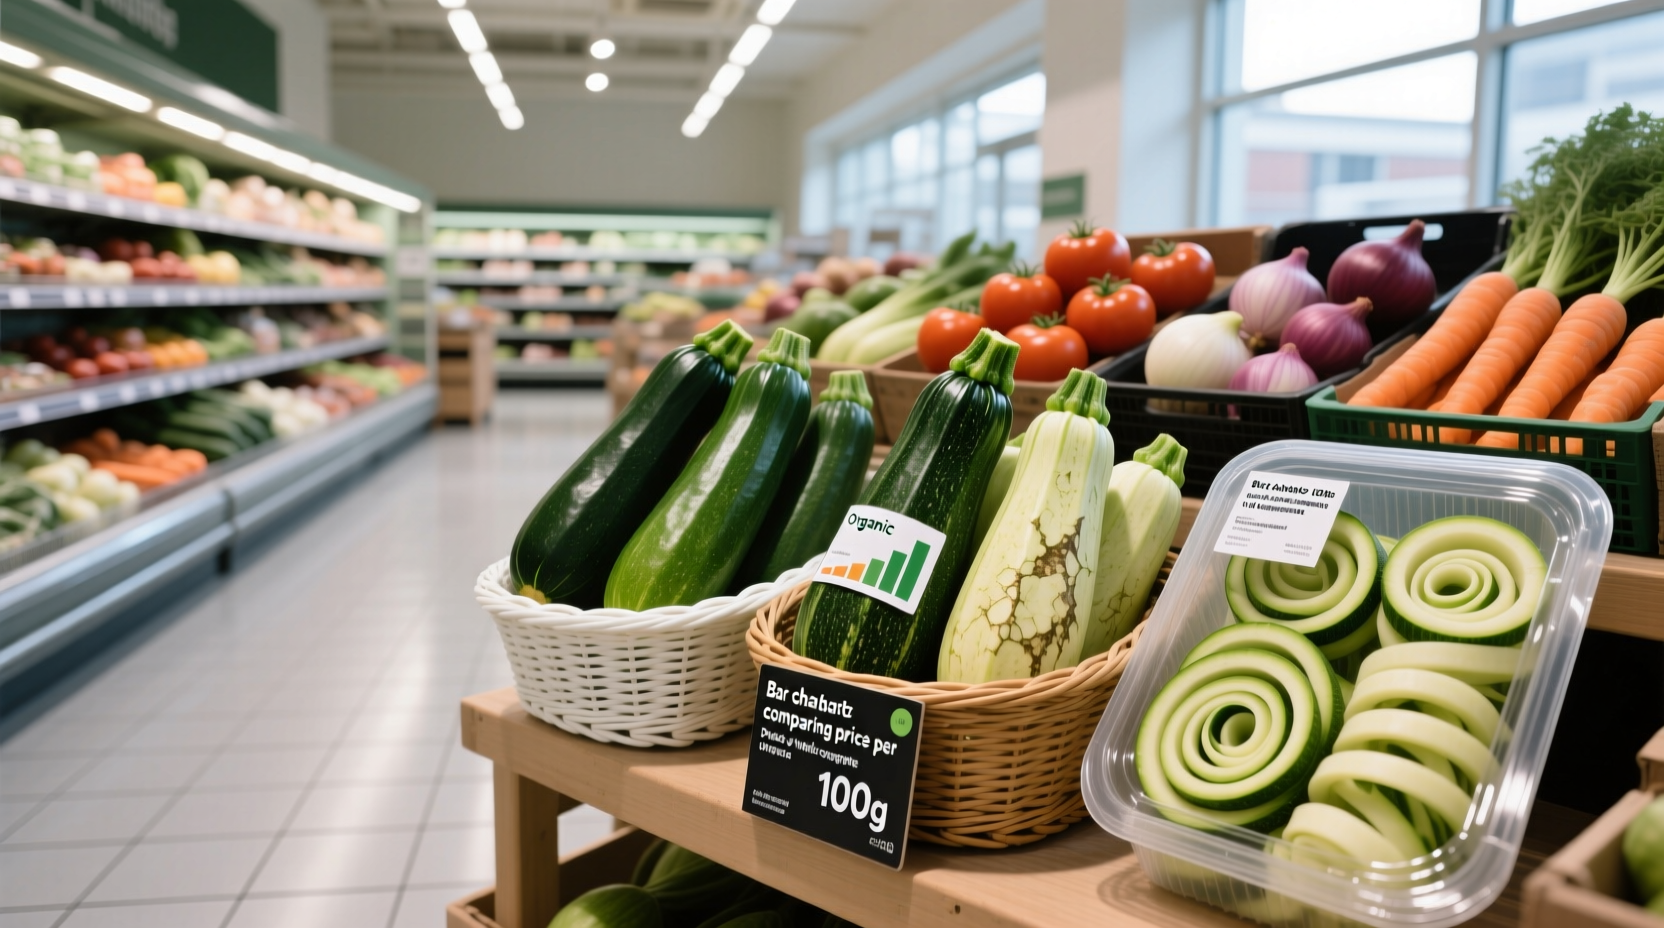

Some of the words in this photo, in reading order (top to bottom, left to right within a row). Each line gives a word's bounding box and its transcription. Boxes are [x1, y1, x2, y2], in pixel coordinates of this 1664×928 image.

[847, 513, 895, 536] Organic
[766, 680, 789, 702] Bar
[763, 706, 832, 741] comparing
[834, 726, 870, 749] price
[873, 738, 898, 757] per
[818, 771, 888, 833] 100g
